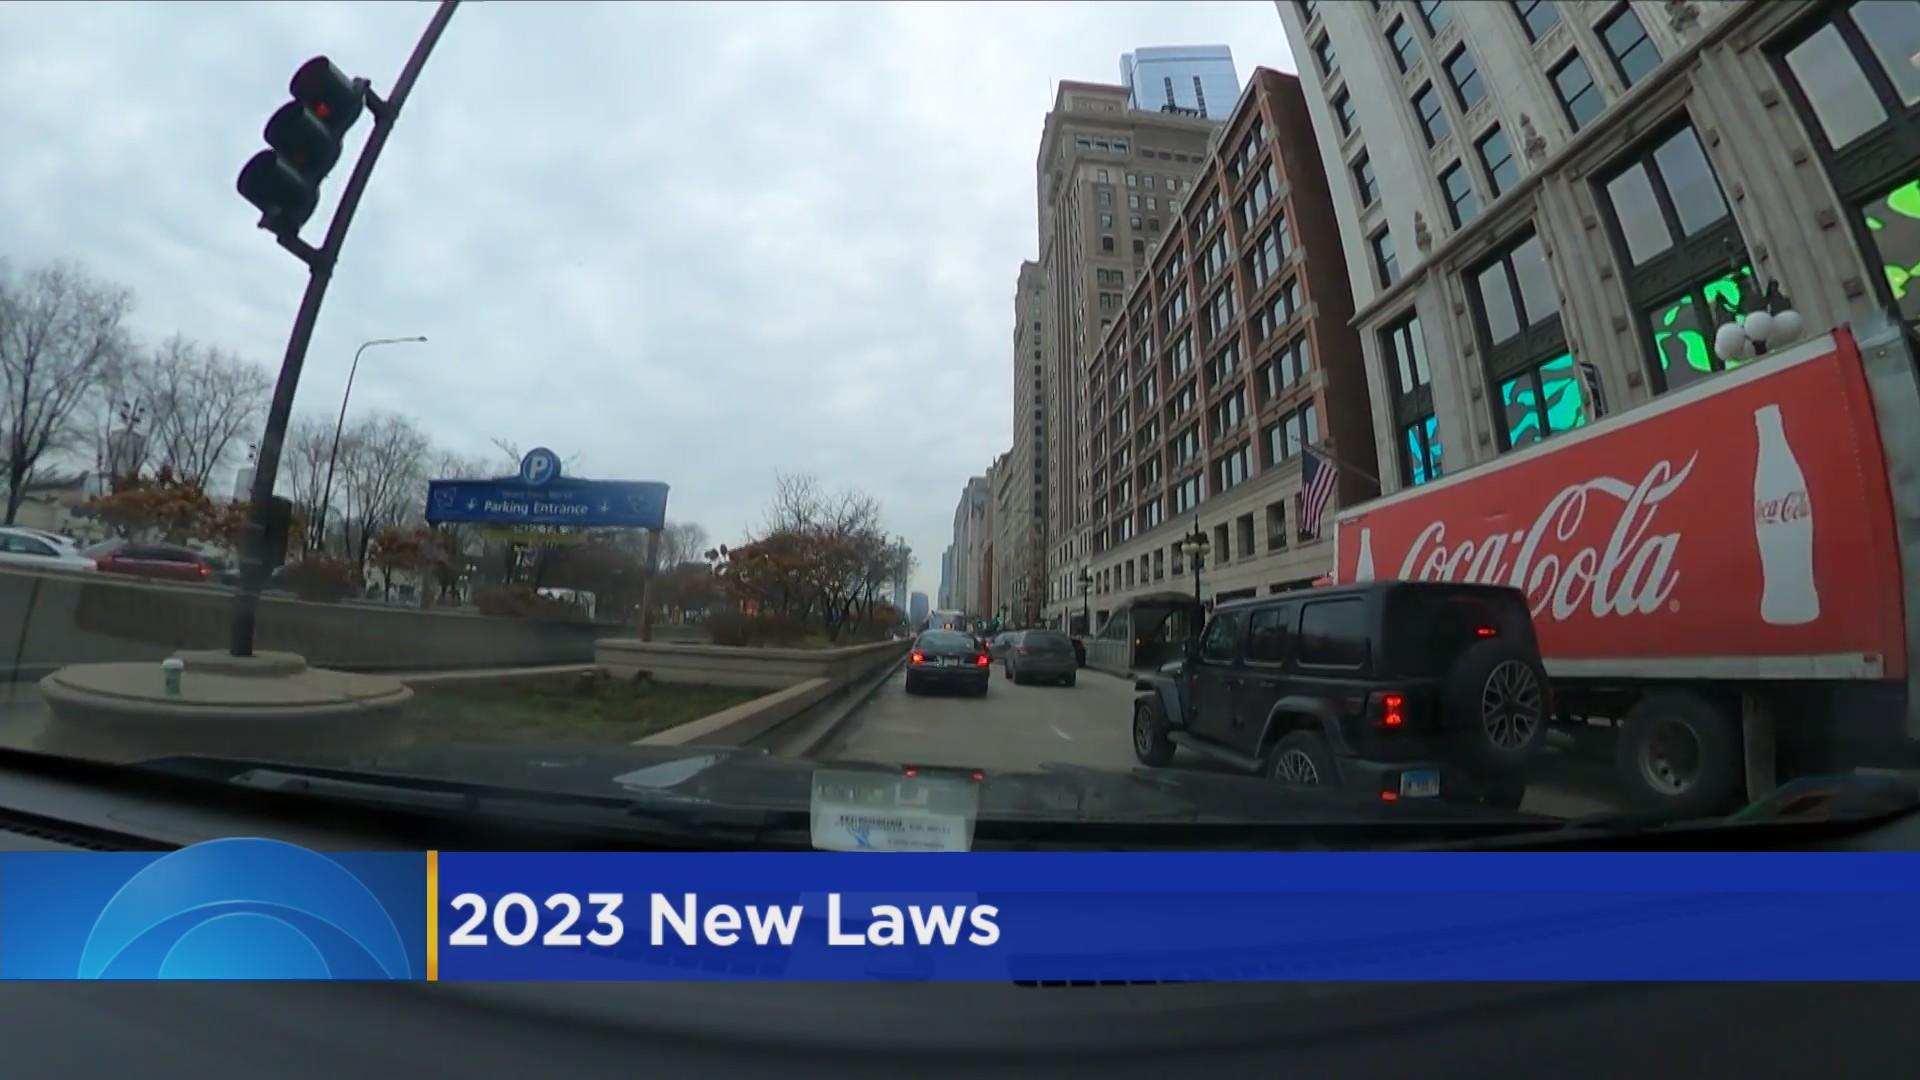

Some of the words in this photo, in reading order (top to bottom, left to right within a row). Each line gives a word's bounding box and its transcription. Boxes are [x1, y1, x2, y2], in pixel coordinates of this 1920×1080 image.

[529, 455, 548, 480] P
[484, 500, 529, 517] Parking
[533, 500, 589, 515] Entrance
